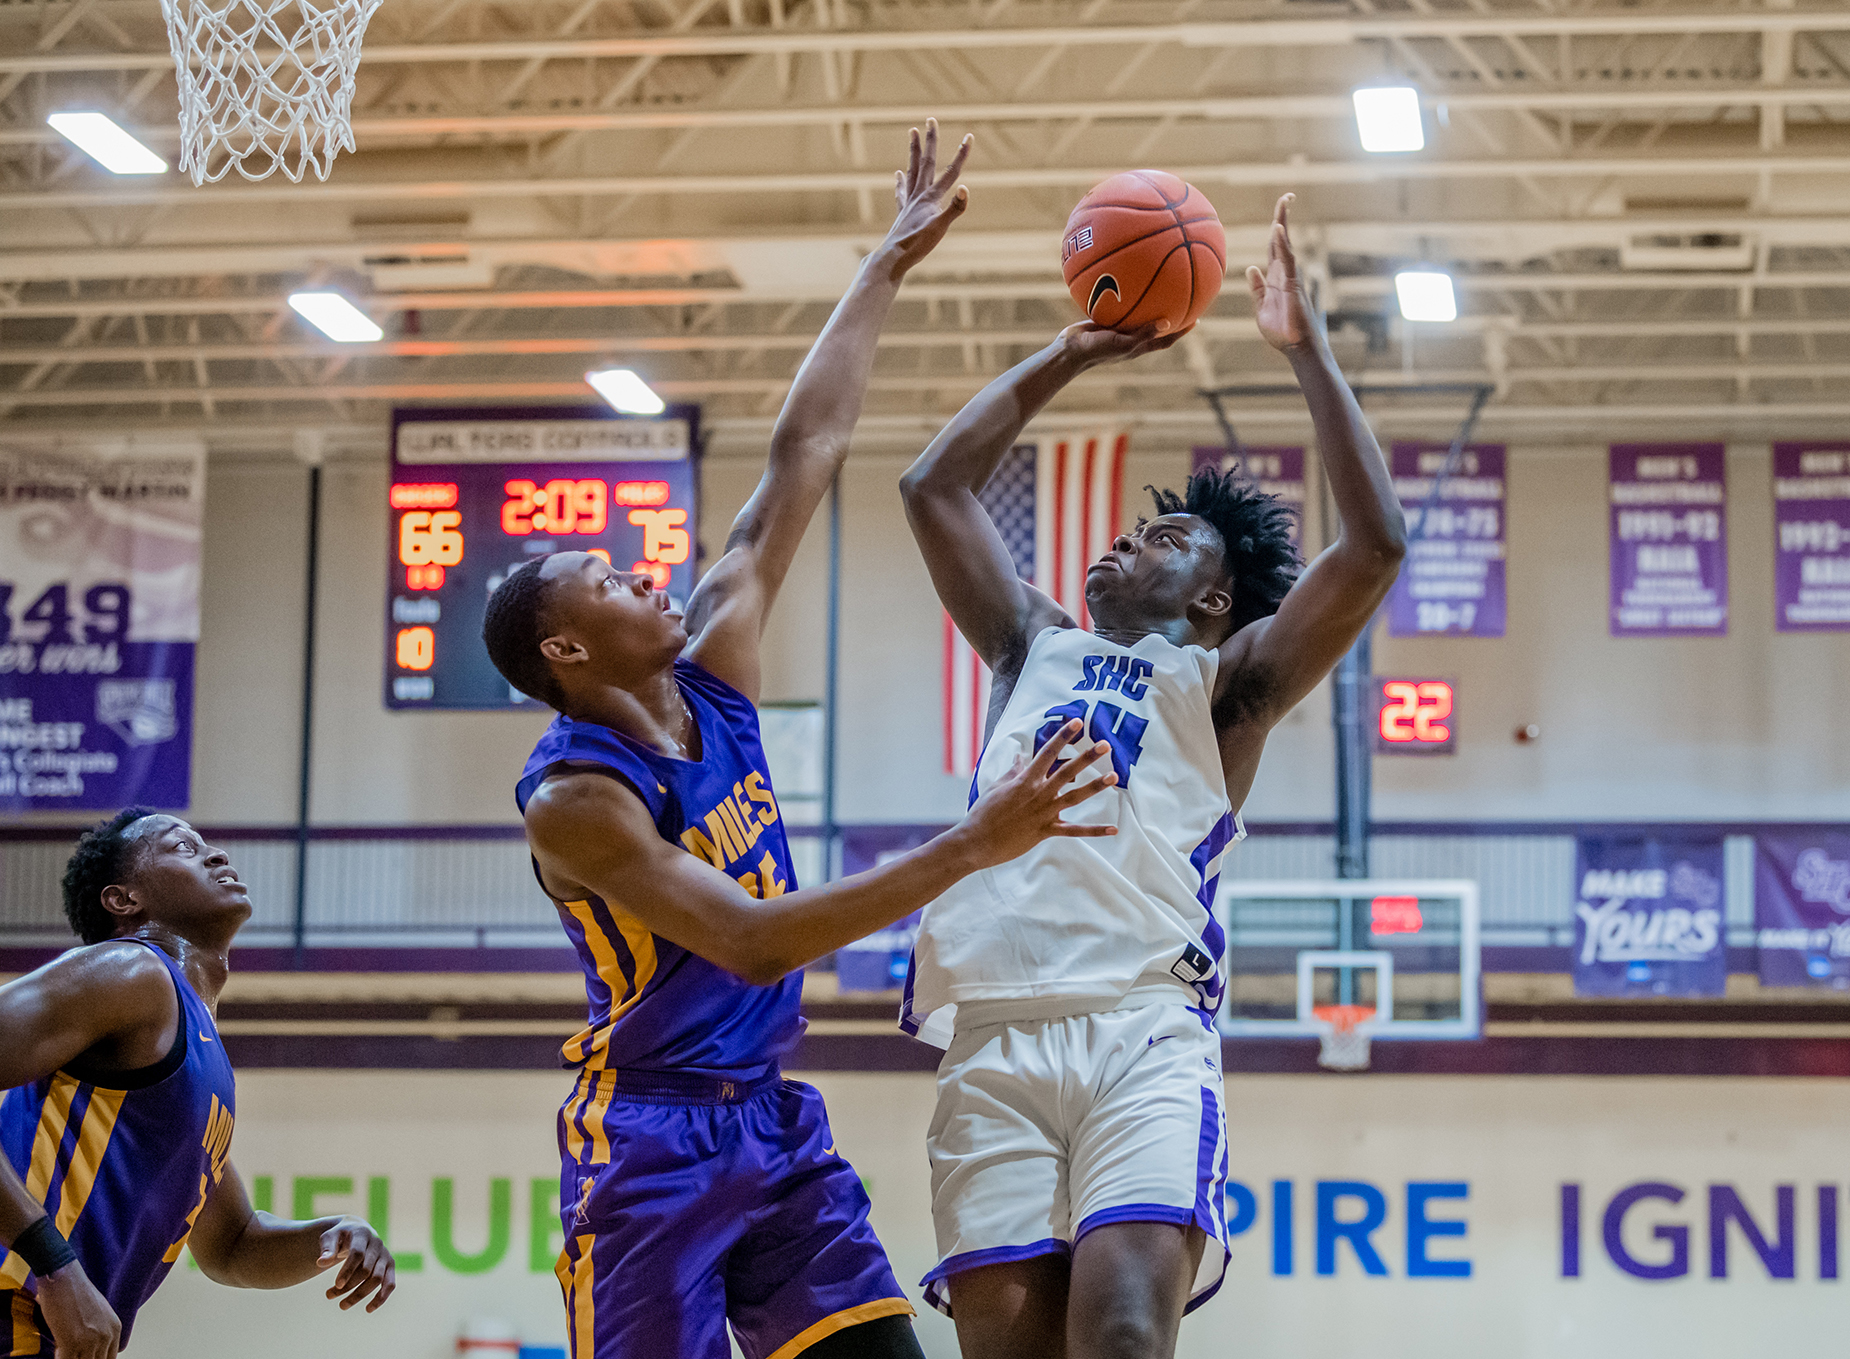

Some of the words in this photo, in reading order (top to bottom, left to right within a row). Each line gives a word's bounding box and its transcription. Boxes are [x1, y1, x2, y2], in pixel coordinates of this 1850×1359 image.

[502, 480, 607, 534] 2:09
[400, 512, 463, 565] 66
[628, 509, 688, 563] 75
[1072, 655, 1154, 701] SHC
[1380, 681, 1453, 741] 22
[680, 770, 778, 872] MILES
[1582, 870, 1667, 898] MAKE
